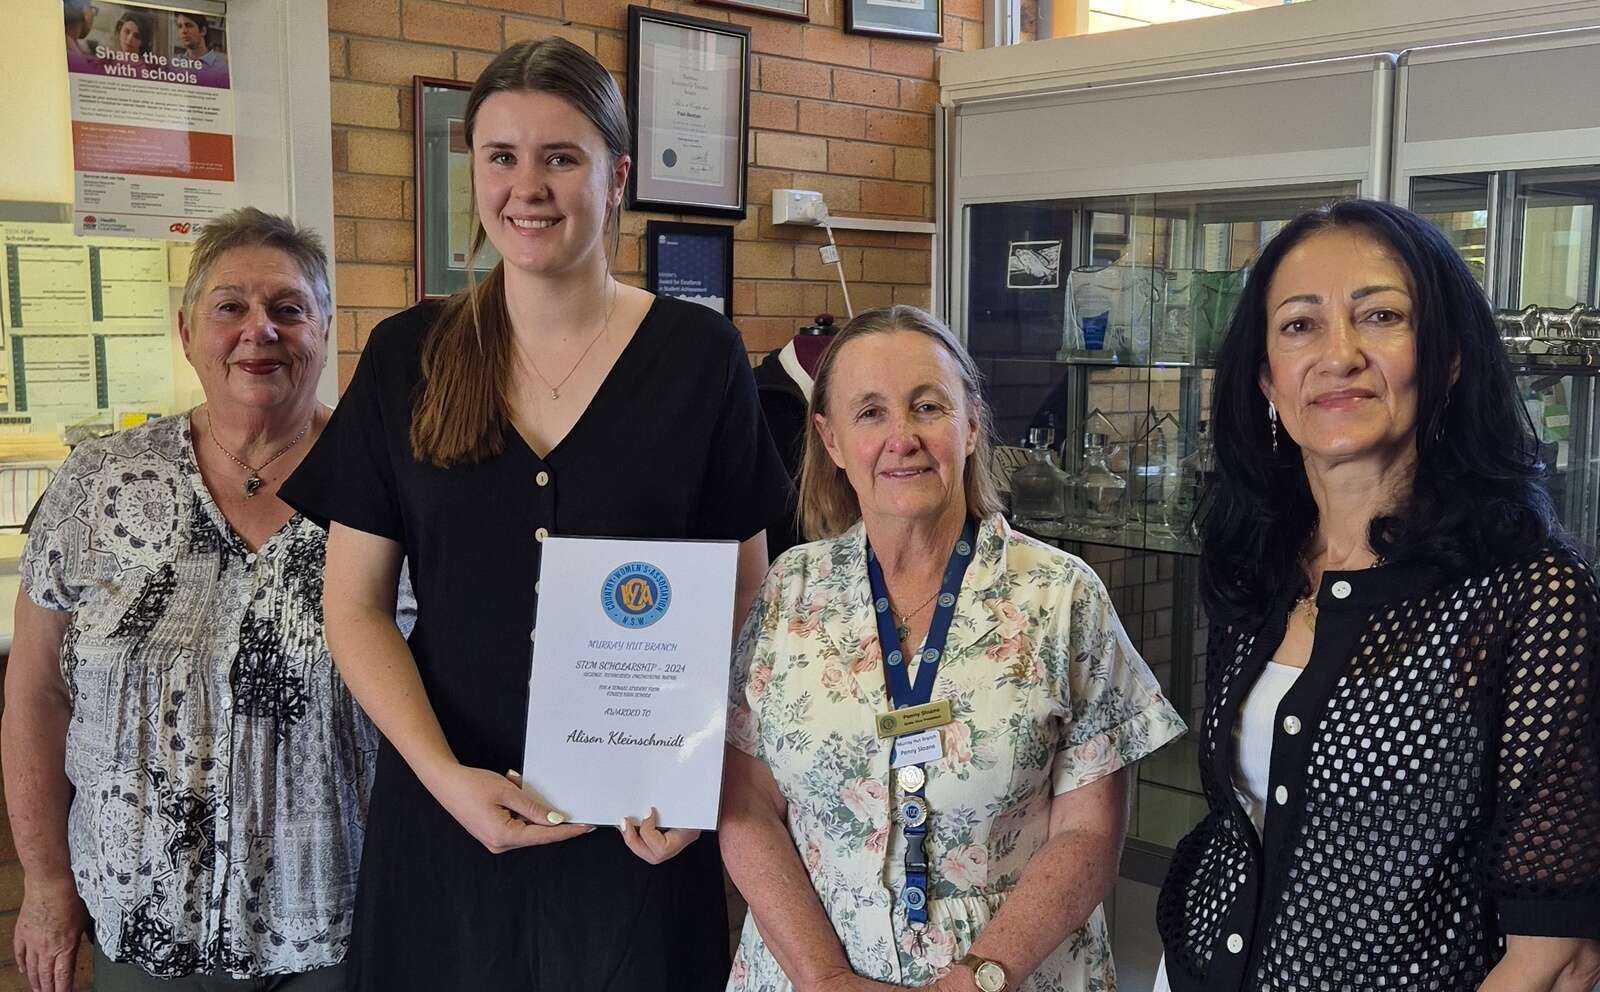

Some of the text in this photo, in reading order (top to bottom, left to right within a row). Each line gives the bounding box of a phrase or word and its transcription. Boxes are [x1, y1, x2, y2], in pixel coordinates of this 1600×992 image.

[95, 46, 203, 70] Share the care
[104, 63, 198, 84] with schools
[604, 564, 669, 613] COUNTRY WOMEN'S ASSOCIATION
[588, 640, 624, 651] MURRAY
[644, 641, 678, 652] BRANCH
[575, 660, 598, 670] STEM
[599, 661, 657, 672] SCHOLARSHIP
[664, 664, 687, 673] 2024
[604, 707, 652, 717] AWARDED TO
[566, 729, 685, 747] Alison Kleinschmidt
[917, 744, 936, 752] Sloane
